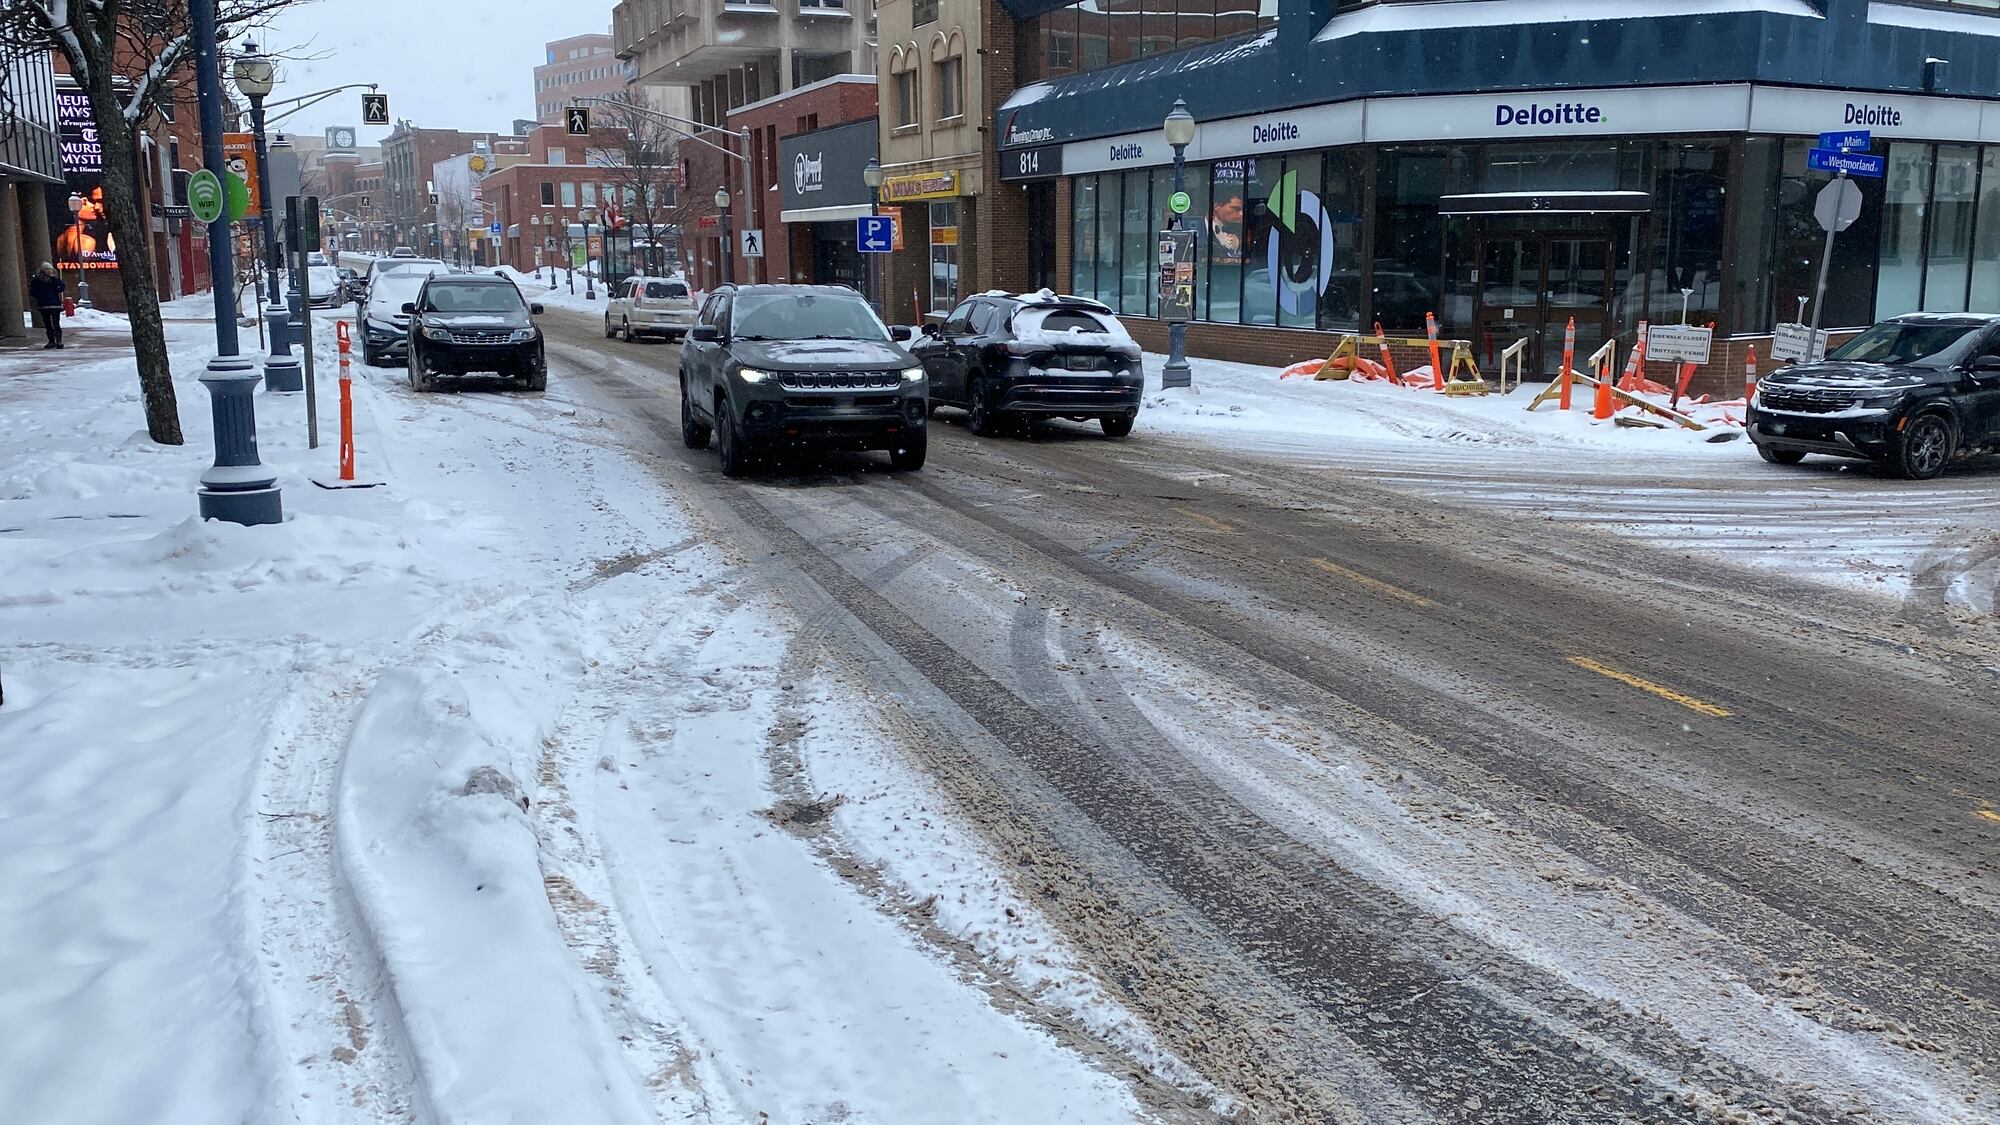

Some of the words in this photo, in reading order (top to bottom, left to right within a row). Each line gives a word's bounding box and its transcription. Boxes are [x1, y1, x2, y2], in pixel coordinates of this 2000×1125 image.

[1844, 135, 1862, 147] Main
[1020, 151, 1038, 174] 814
[1829, 155, 1876, 172] Westmorland
[868, 220, 882, 236] P
